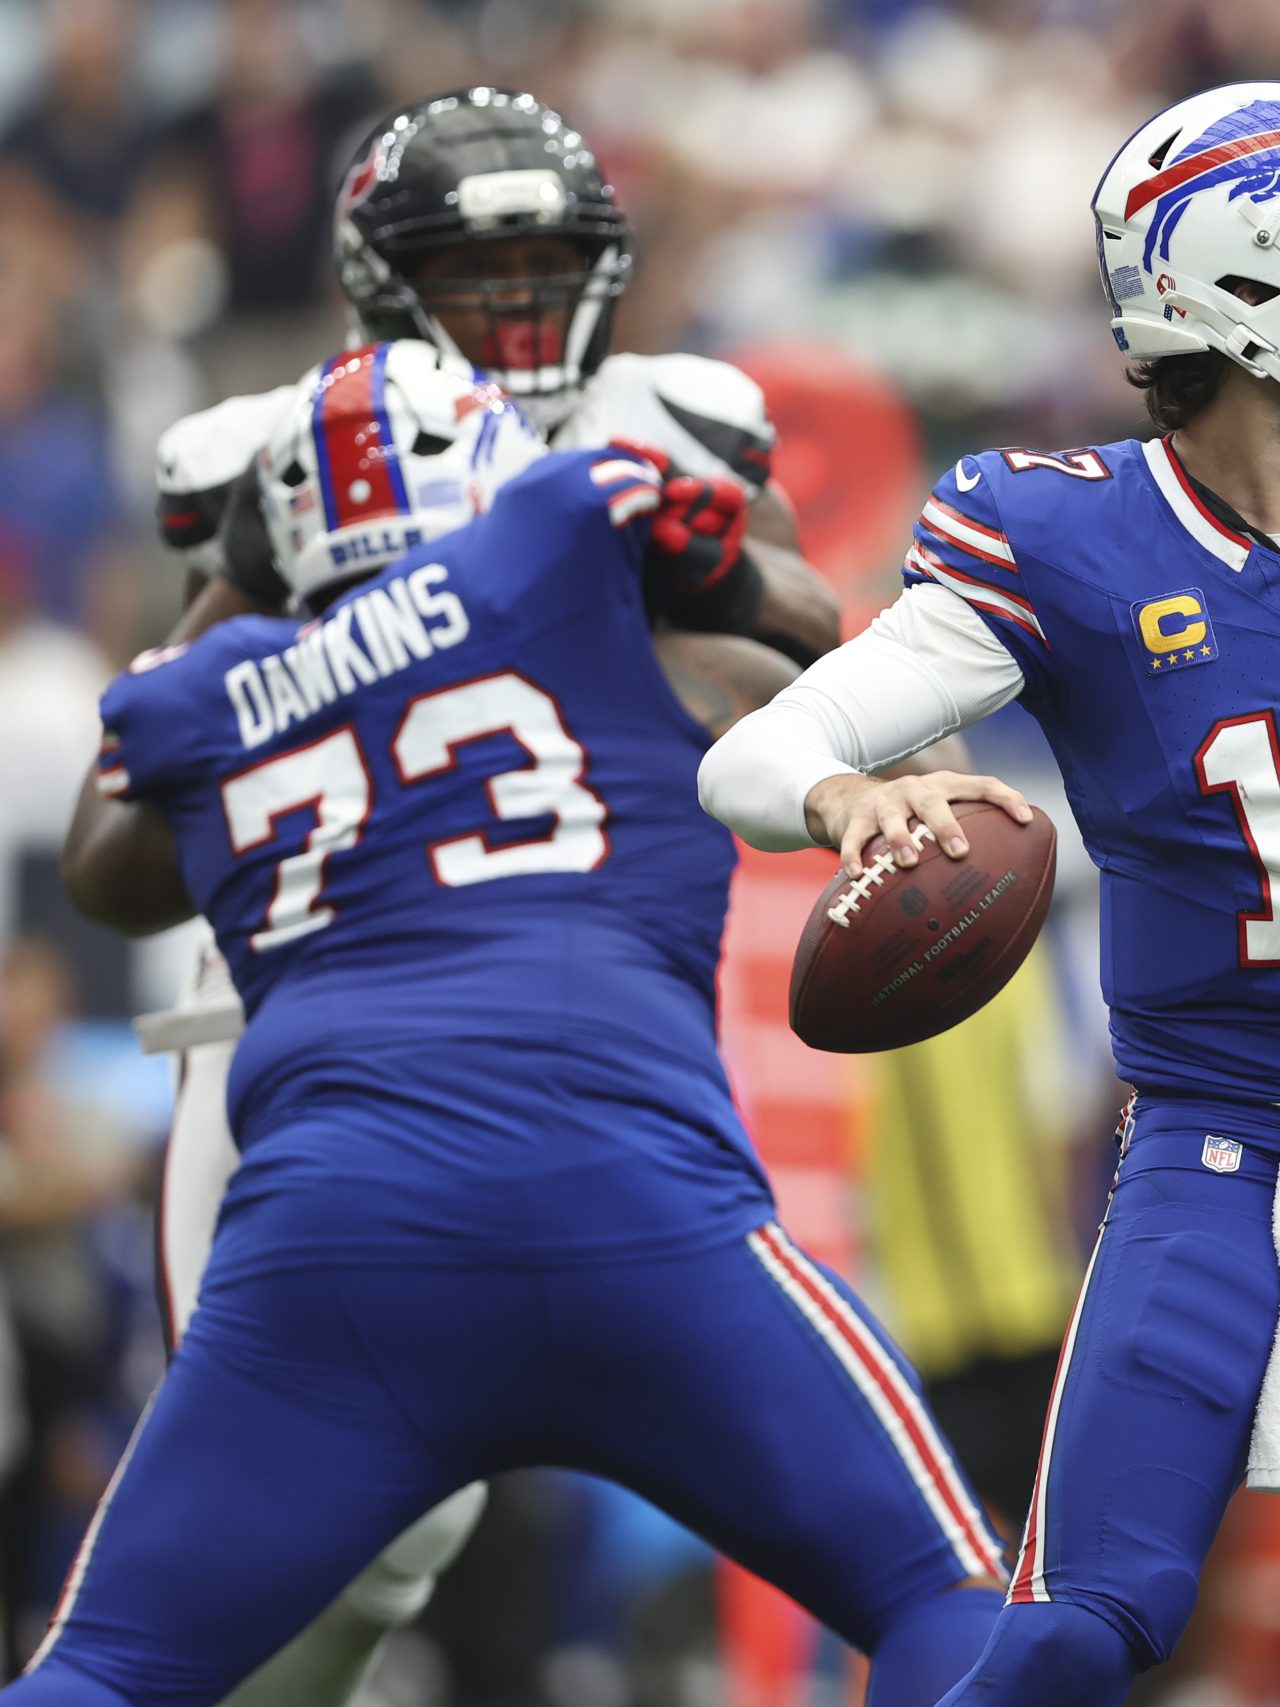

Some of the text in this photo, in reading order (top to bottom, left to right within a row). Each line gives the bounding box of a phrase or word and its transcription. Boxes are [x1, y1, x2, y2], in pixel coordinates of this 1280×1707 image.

[1000, 447, 1114, 482] 7
[225, 563, 470, 750] DAWKINS
[1138, 595, 1207, 654] C
[219, 668, 611, 953] 73
[872, 961, 923, 1006] NATIONAL
[924, 909, 979, 962] FOOTBALL
[979, 869, 1017, 910] LEAGUE
[1206, 1148, 1234, 1167] NFL
